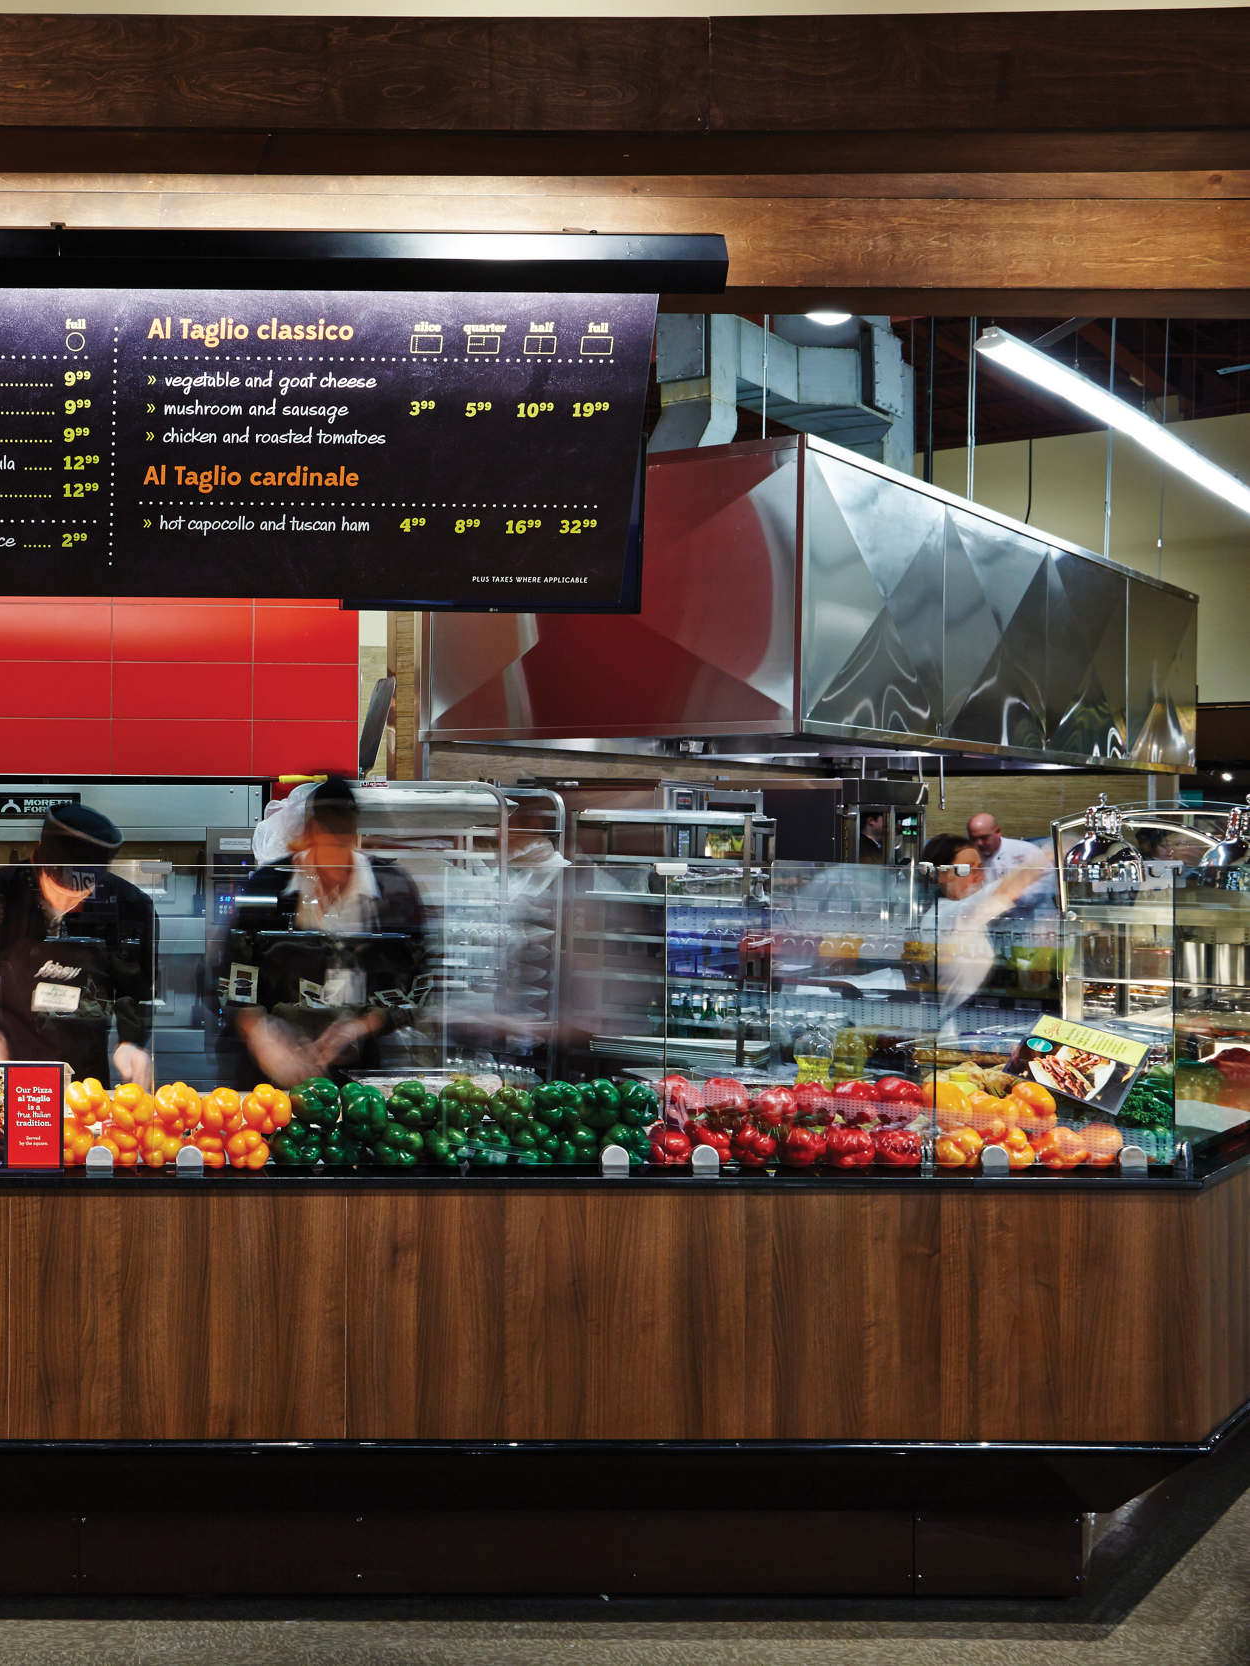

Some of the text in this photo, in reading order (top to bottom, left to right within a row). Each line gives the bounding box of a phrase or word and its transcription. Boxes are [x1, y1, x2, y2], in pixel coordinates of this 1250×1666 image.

[65, 319, 86, 329] full
[147, 317, 354, 348] Al Taglio classico
[414, 322, 609, 335] slice quarter half full
[164, 370, 377, 395] vegetable and goat cheese
[164, 398, 349, 424] mushroom and sausage
[163, 426, 386, 444] chicken and roasted tomatoes
[143, 465, 359, 493] Al Taglio cardinale
[160, 514, 370, 536] hot capocollo and tuscan ham
[27, 1095, 50, 1103] Taglio
[16, 1119, 51, 1127] tradition.
